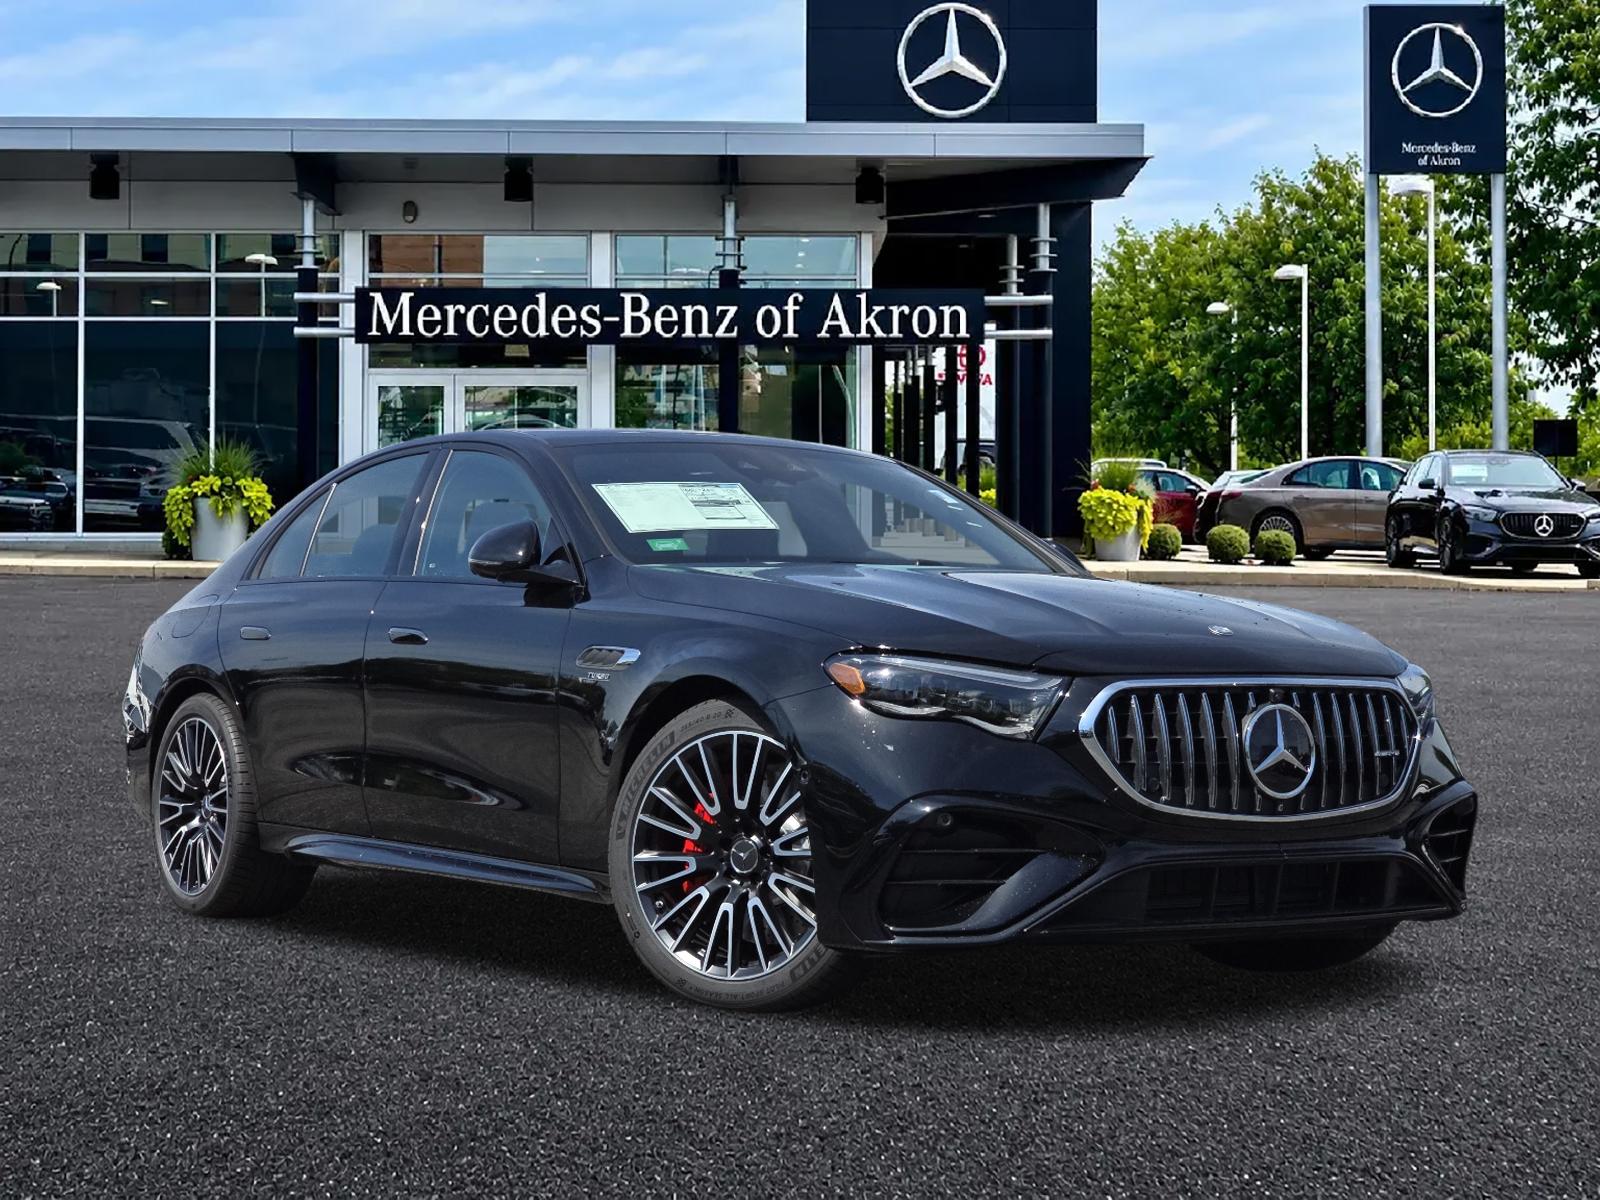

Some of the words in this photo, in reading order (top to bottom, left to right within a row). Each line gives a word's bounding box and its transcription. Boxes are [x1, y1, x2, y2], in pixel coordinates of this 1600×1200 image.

[1401, 141, 1477, 154] Mercedes-Benz
[1417, 154, 1428, 166] of
[1430, 154, 1461, 166] Akron
[367, 291, 739, 338] Mercedes-Benz
[755, 292, 804, 338] of
[816, 292, 970, 338] Akron
